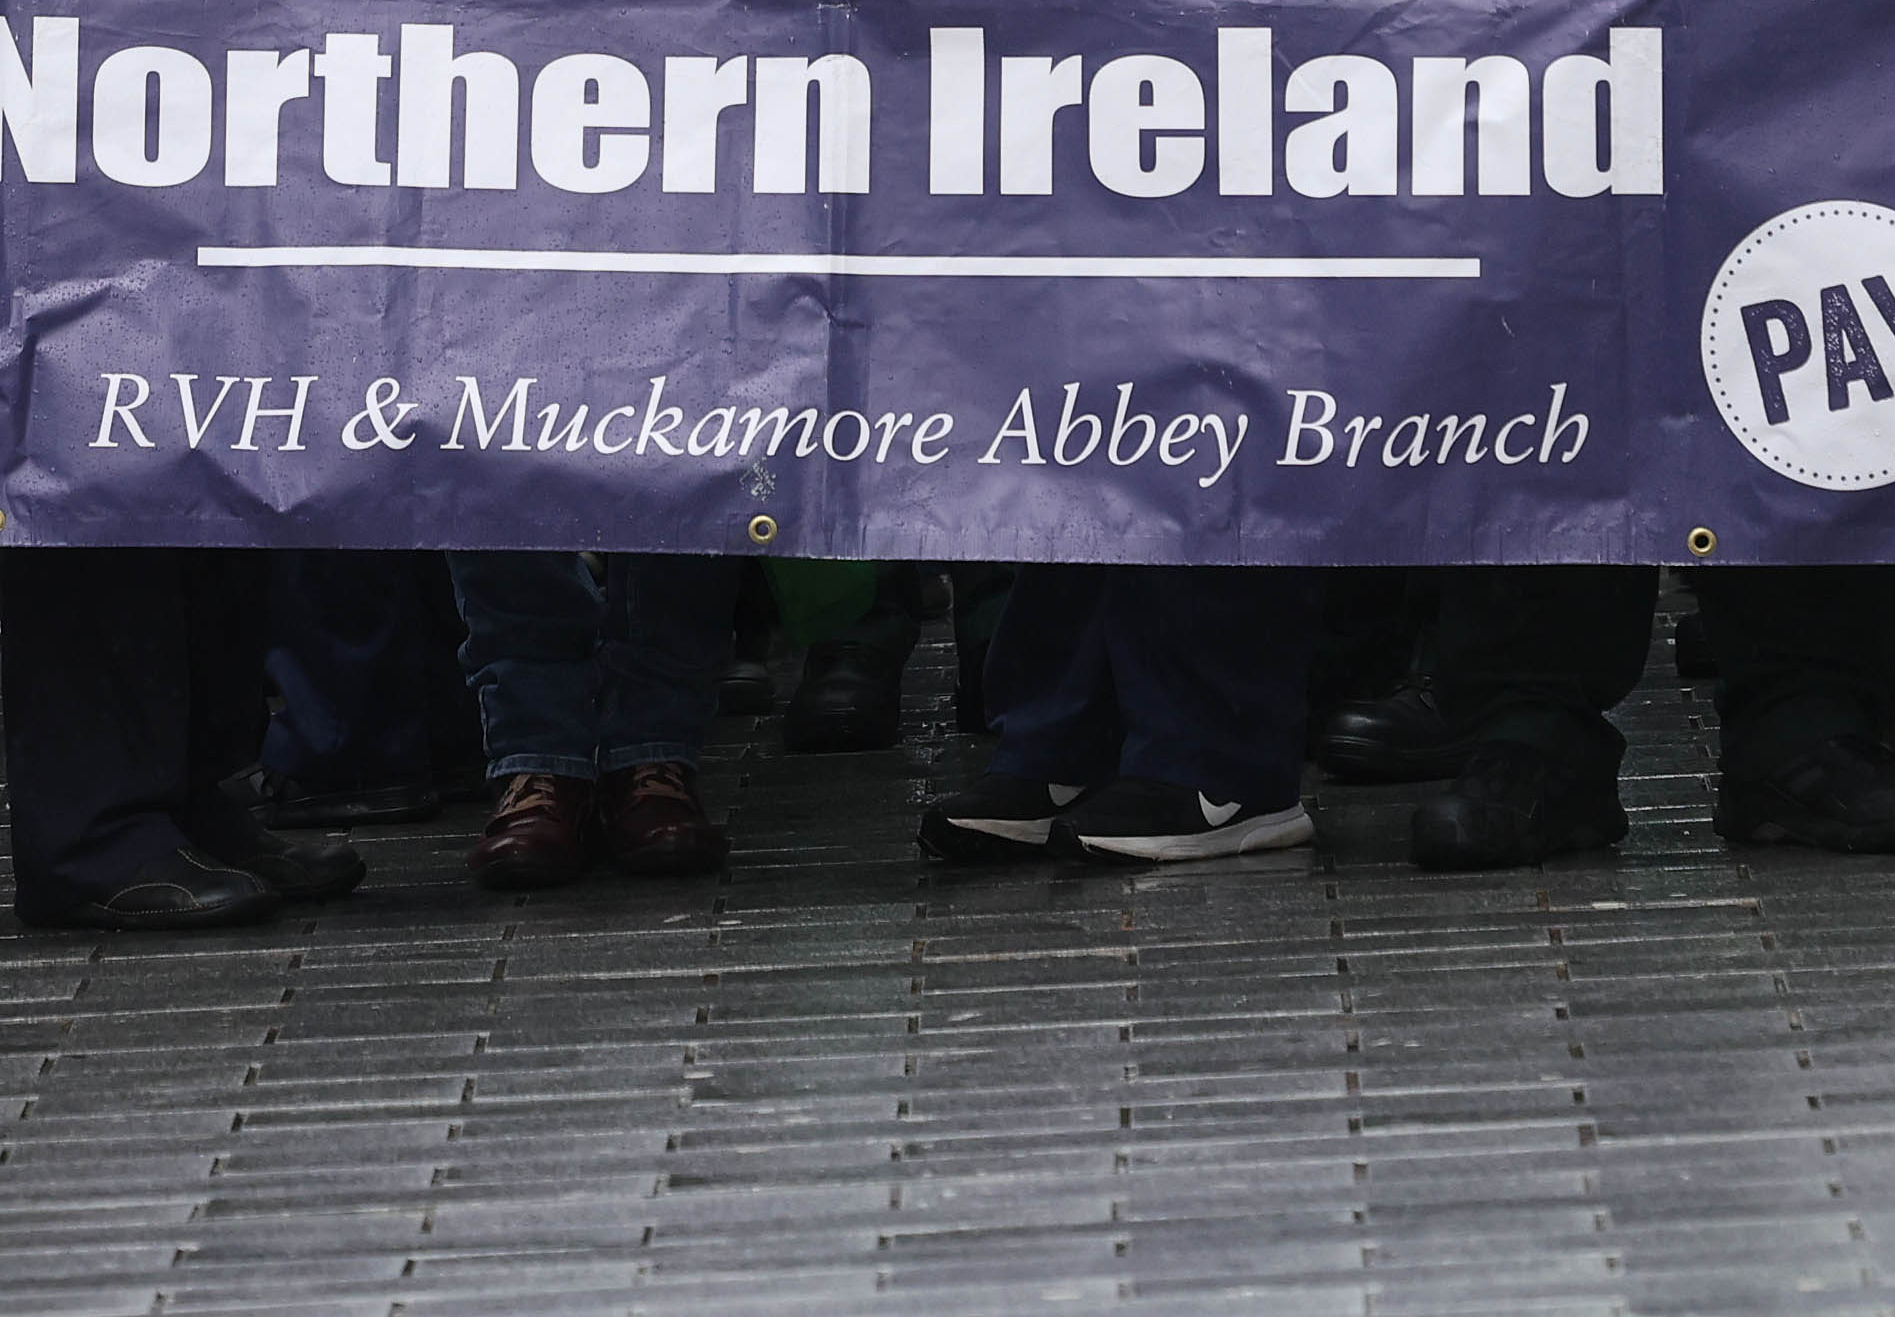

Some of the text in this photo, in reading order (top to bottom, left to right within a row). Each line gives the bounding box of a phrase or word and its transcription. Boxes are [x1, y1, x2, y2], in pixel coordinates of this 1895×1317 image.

[930, 26, 1664, 198] Ireland
[87, 371, 1590, 488] RVH & Muckamore Abbey Branch
